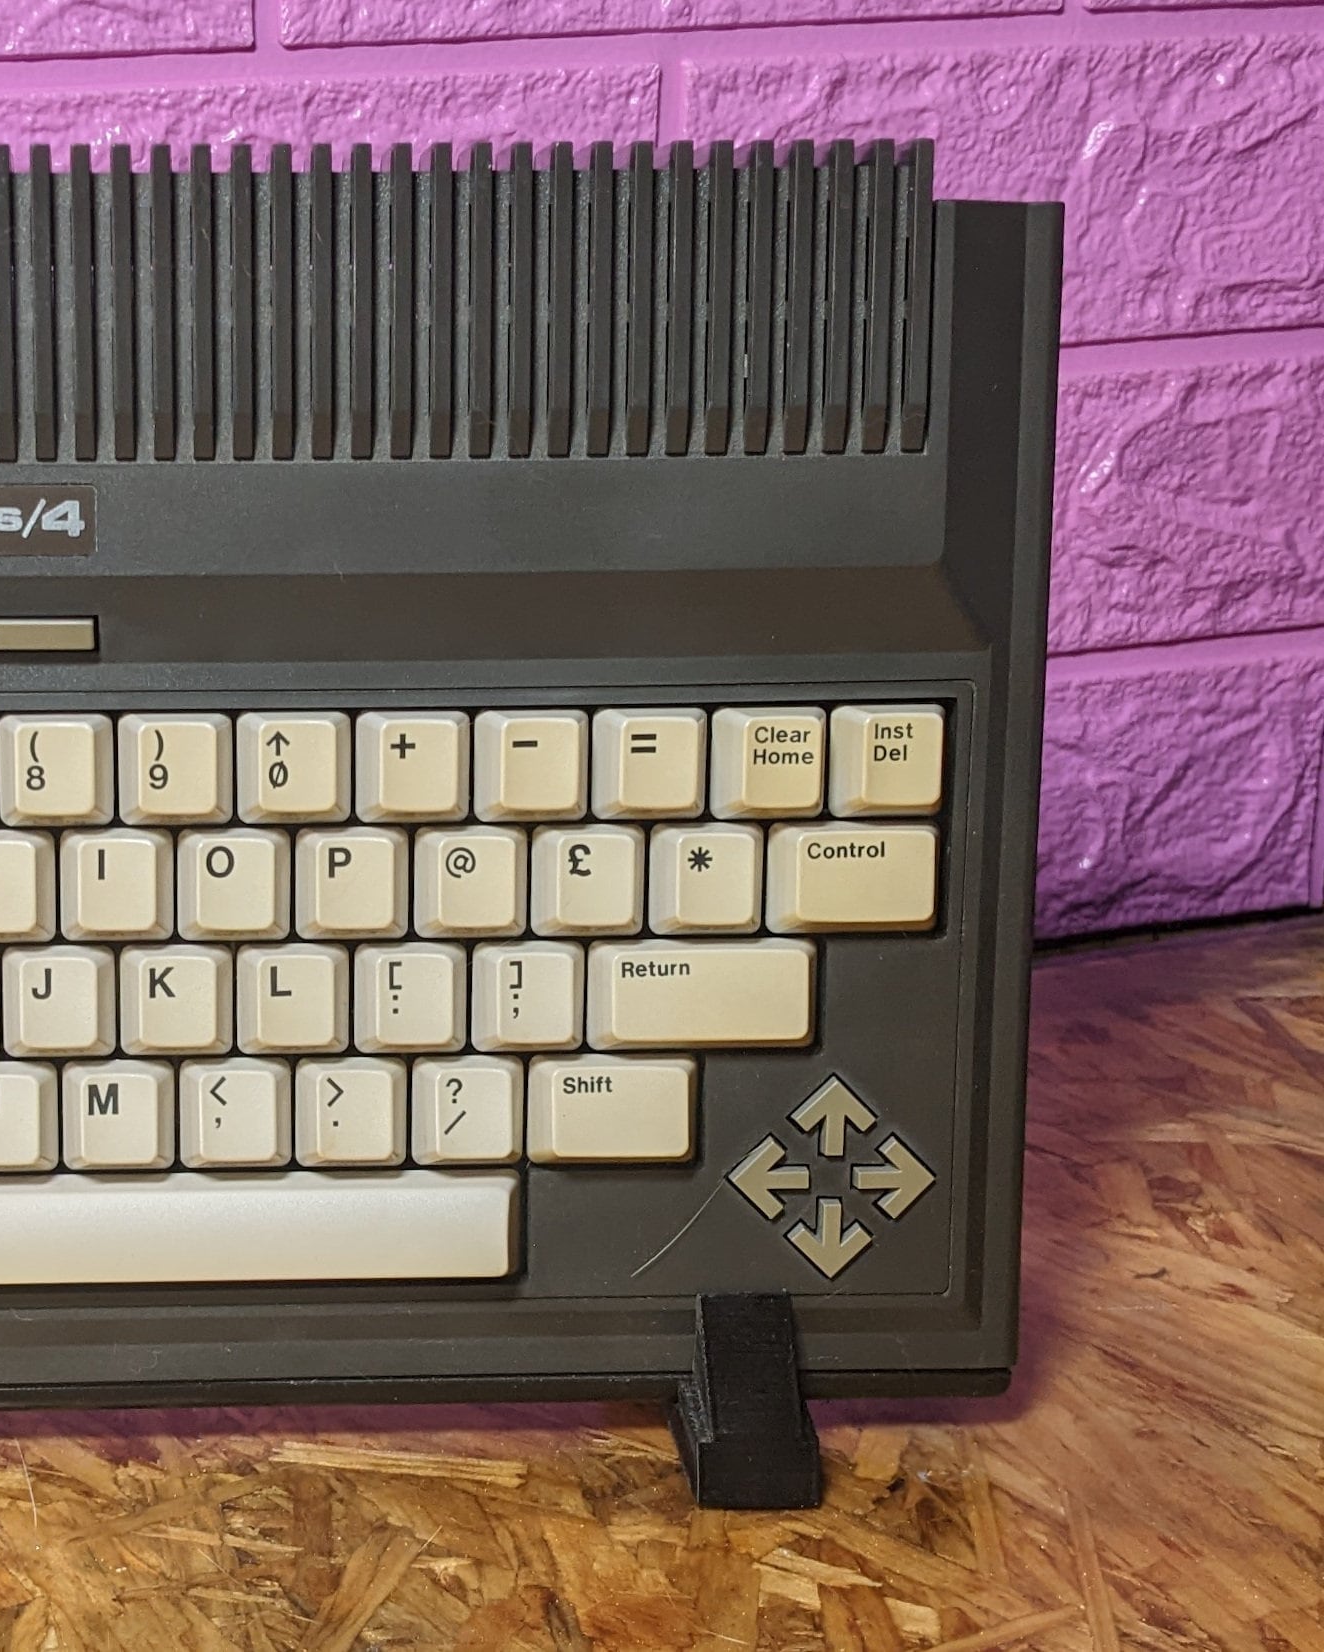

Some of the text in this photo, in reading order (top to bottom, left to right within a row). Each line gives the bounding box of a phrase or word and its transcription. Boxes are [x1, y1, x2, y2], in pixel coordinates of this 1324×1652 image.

[154, 729, 164, 762] )
[390, 733, 416, 759] +
[630, 733, 657, 754] =
[754, 726, 811, 744] Clear
[874, 722, 913, 740] Inst
[29, 731, 39, 763] (
[753, 748, 814, 765] Home
[873, 744, 908, 762] Del
[26, 765, 46, 791] 8
[148, 763, 169, 790] 9
[97, 849, 105, 881] I
[205, 845, 235, 879] O
[328, 847, 352, 879] P
[445, 846, 476, 879] @
[567, 843, 592, 877] £
[807, 841, 885, 860] Control
[31, 968, 52, 1000] J
[149, 966, 176, 999] K
[270, 965, 292, 997] L
[388, 961, 403, 991] [
[509, 960, 523, 990] ]
[621, 961, 690, 979] Return
[87, 1083, 119, 1116] M
[209, 1076, 227, 1106] <
[326, 1077, 344, 1108] >
[445, 1078, 463, 1104] ?
[563, 1076, 613, 1095] Shift
[443, 1110, 467, 1136] /
